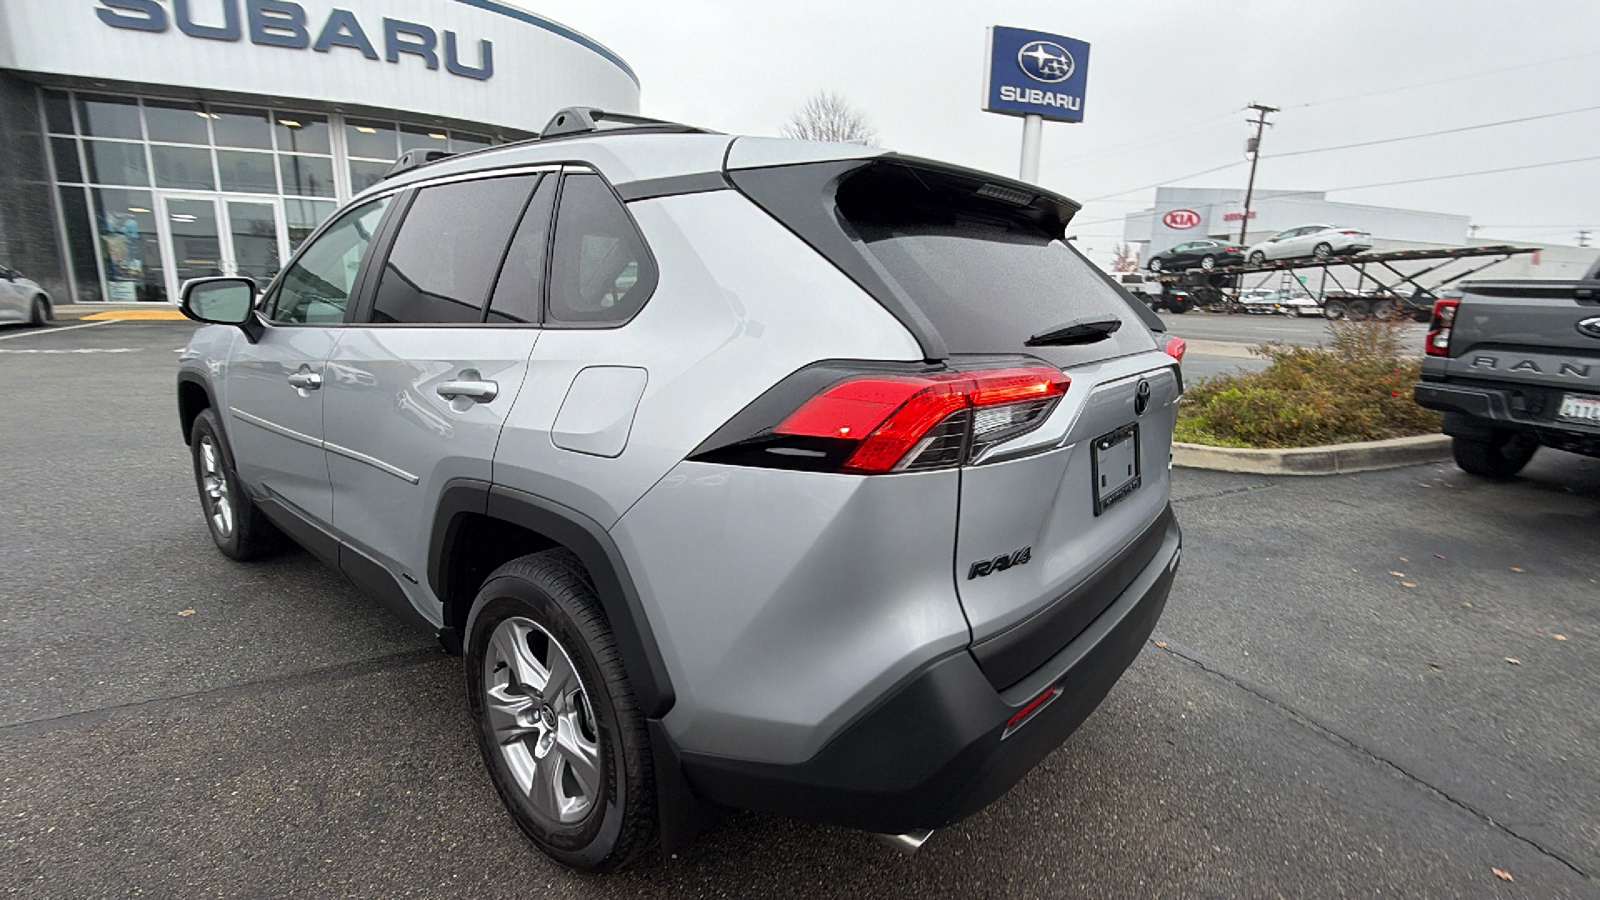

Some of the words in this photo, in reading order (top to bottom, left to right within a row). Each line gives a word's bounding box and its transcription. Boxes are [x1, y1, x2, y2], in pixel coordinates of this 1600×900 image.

[94, 0, 494, 80] SUBARU
[1000, 85, 1080, 111] SUBARU
[1168, 212, 1197, 227] KIA
[967, 545, 1032, 580] RAV4
